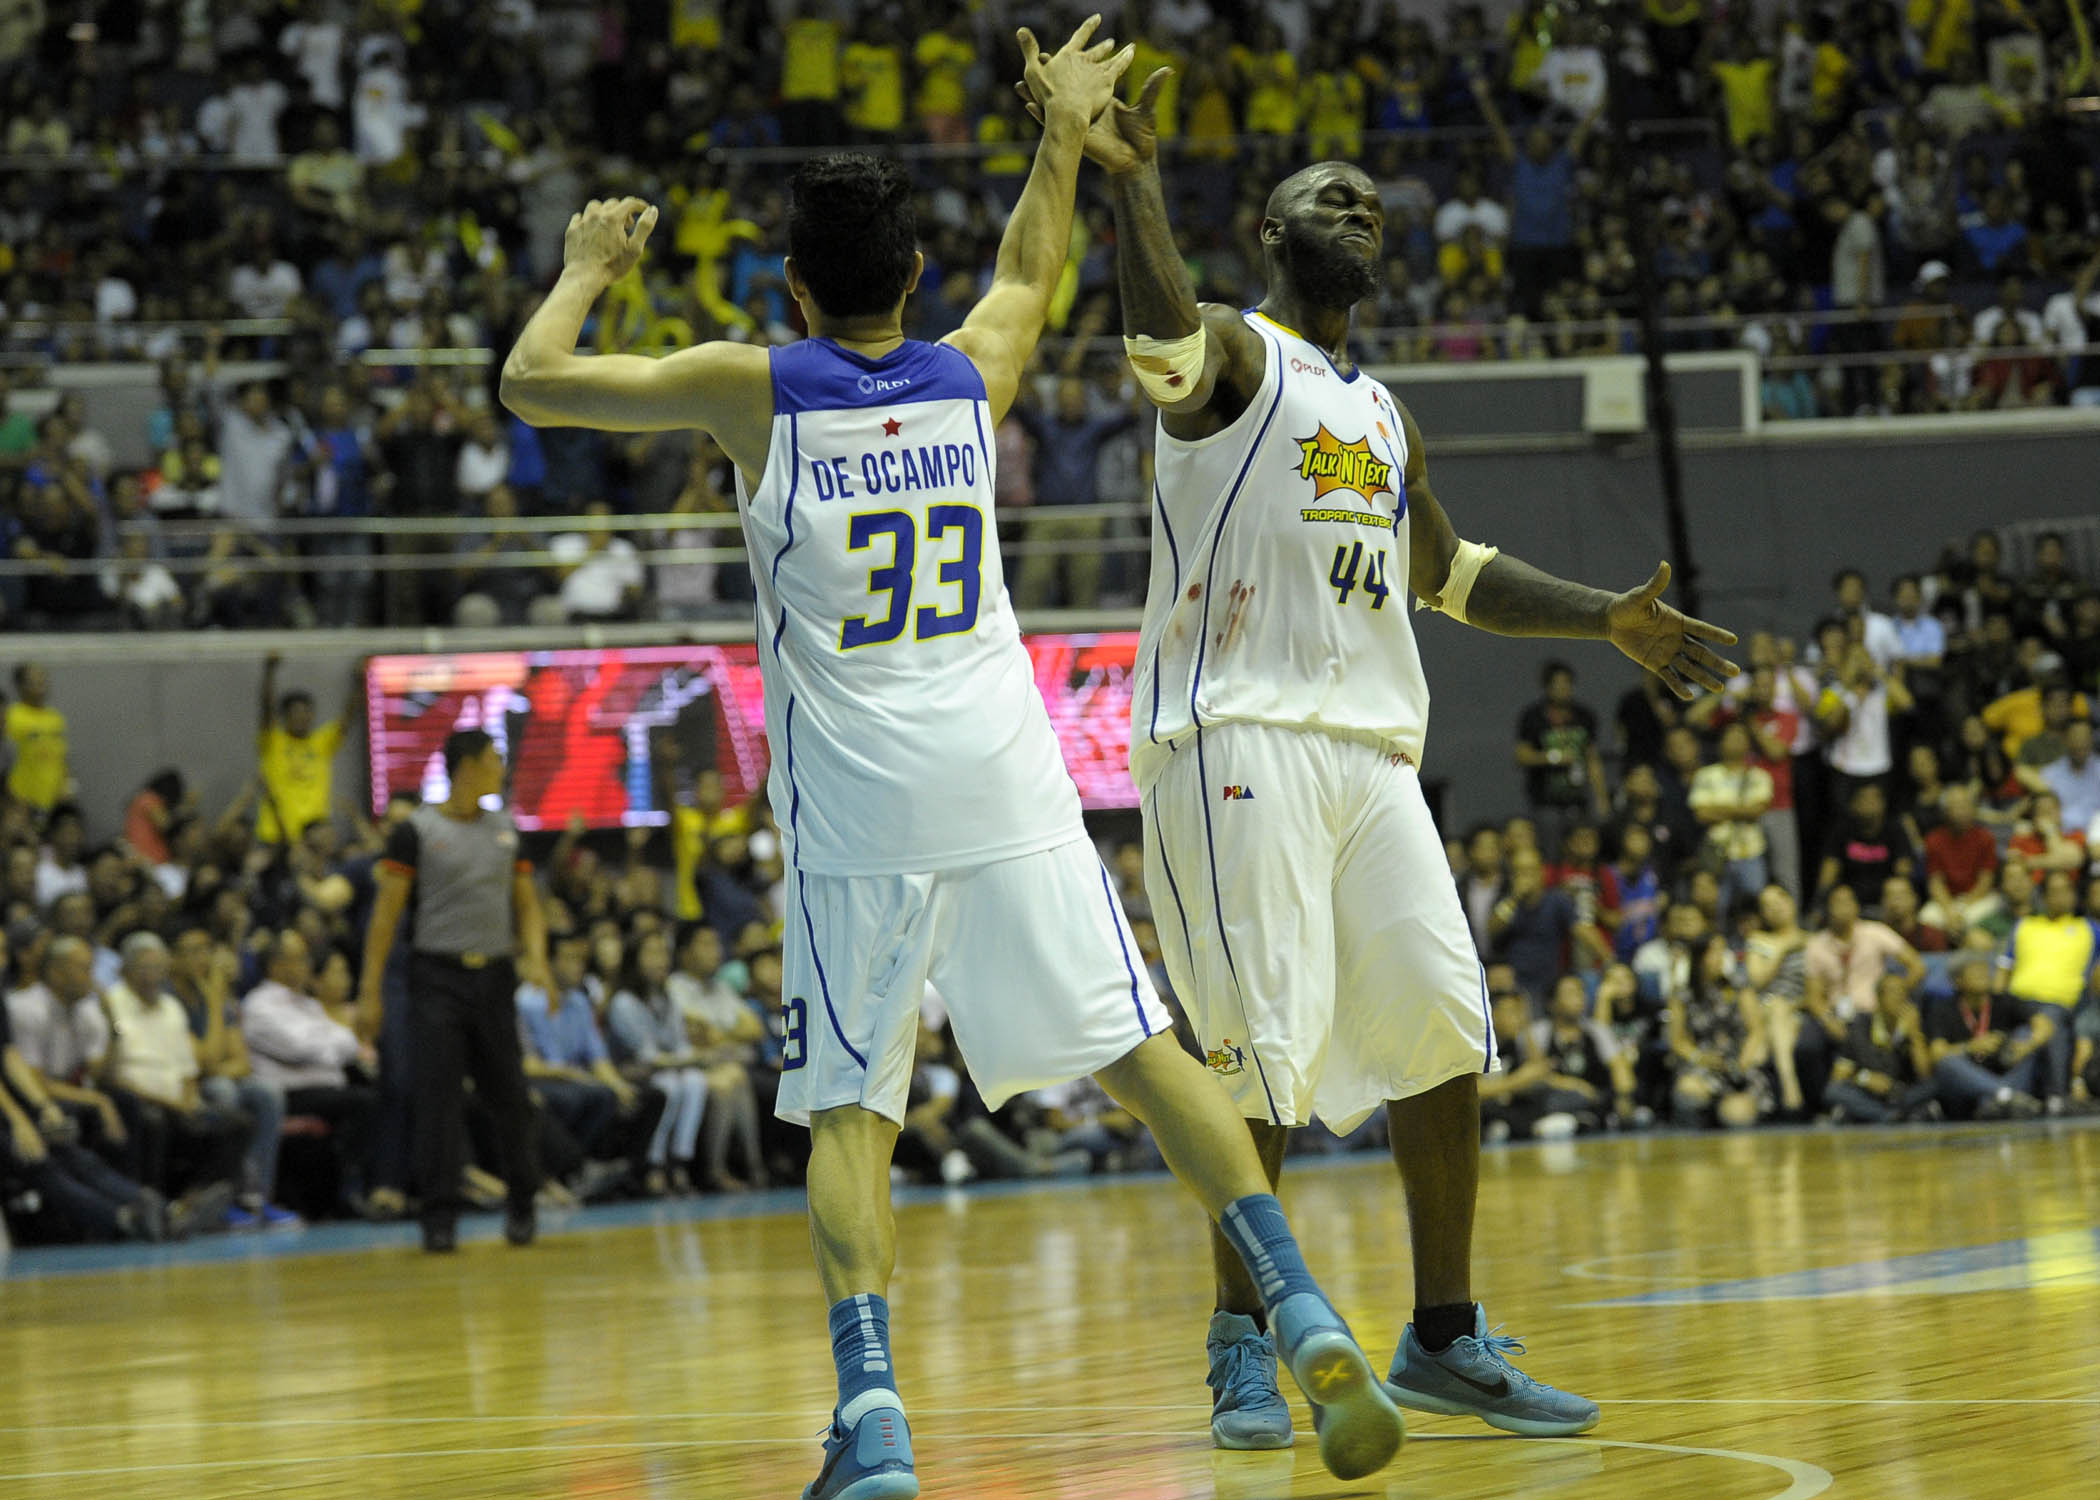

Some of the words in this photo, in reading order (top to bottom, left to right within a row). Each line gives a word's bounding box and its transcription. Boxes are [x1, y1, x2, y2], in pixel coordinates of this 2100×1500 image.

[811, 456, 855, 502] DE
[861, 443, 976, 495] OCAMPO
[1300, 440, 1338, 480] TALK
[1356, 450, 1390, 489] TEXT
[837, 502, 984, 653] 33
[1329, 540, 1389, 611] 44
